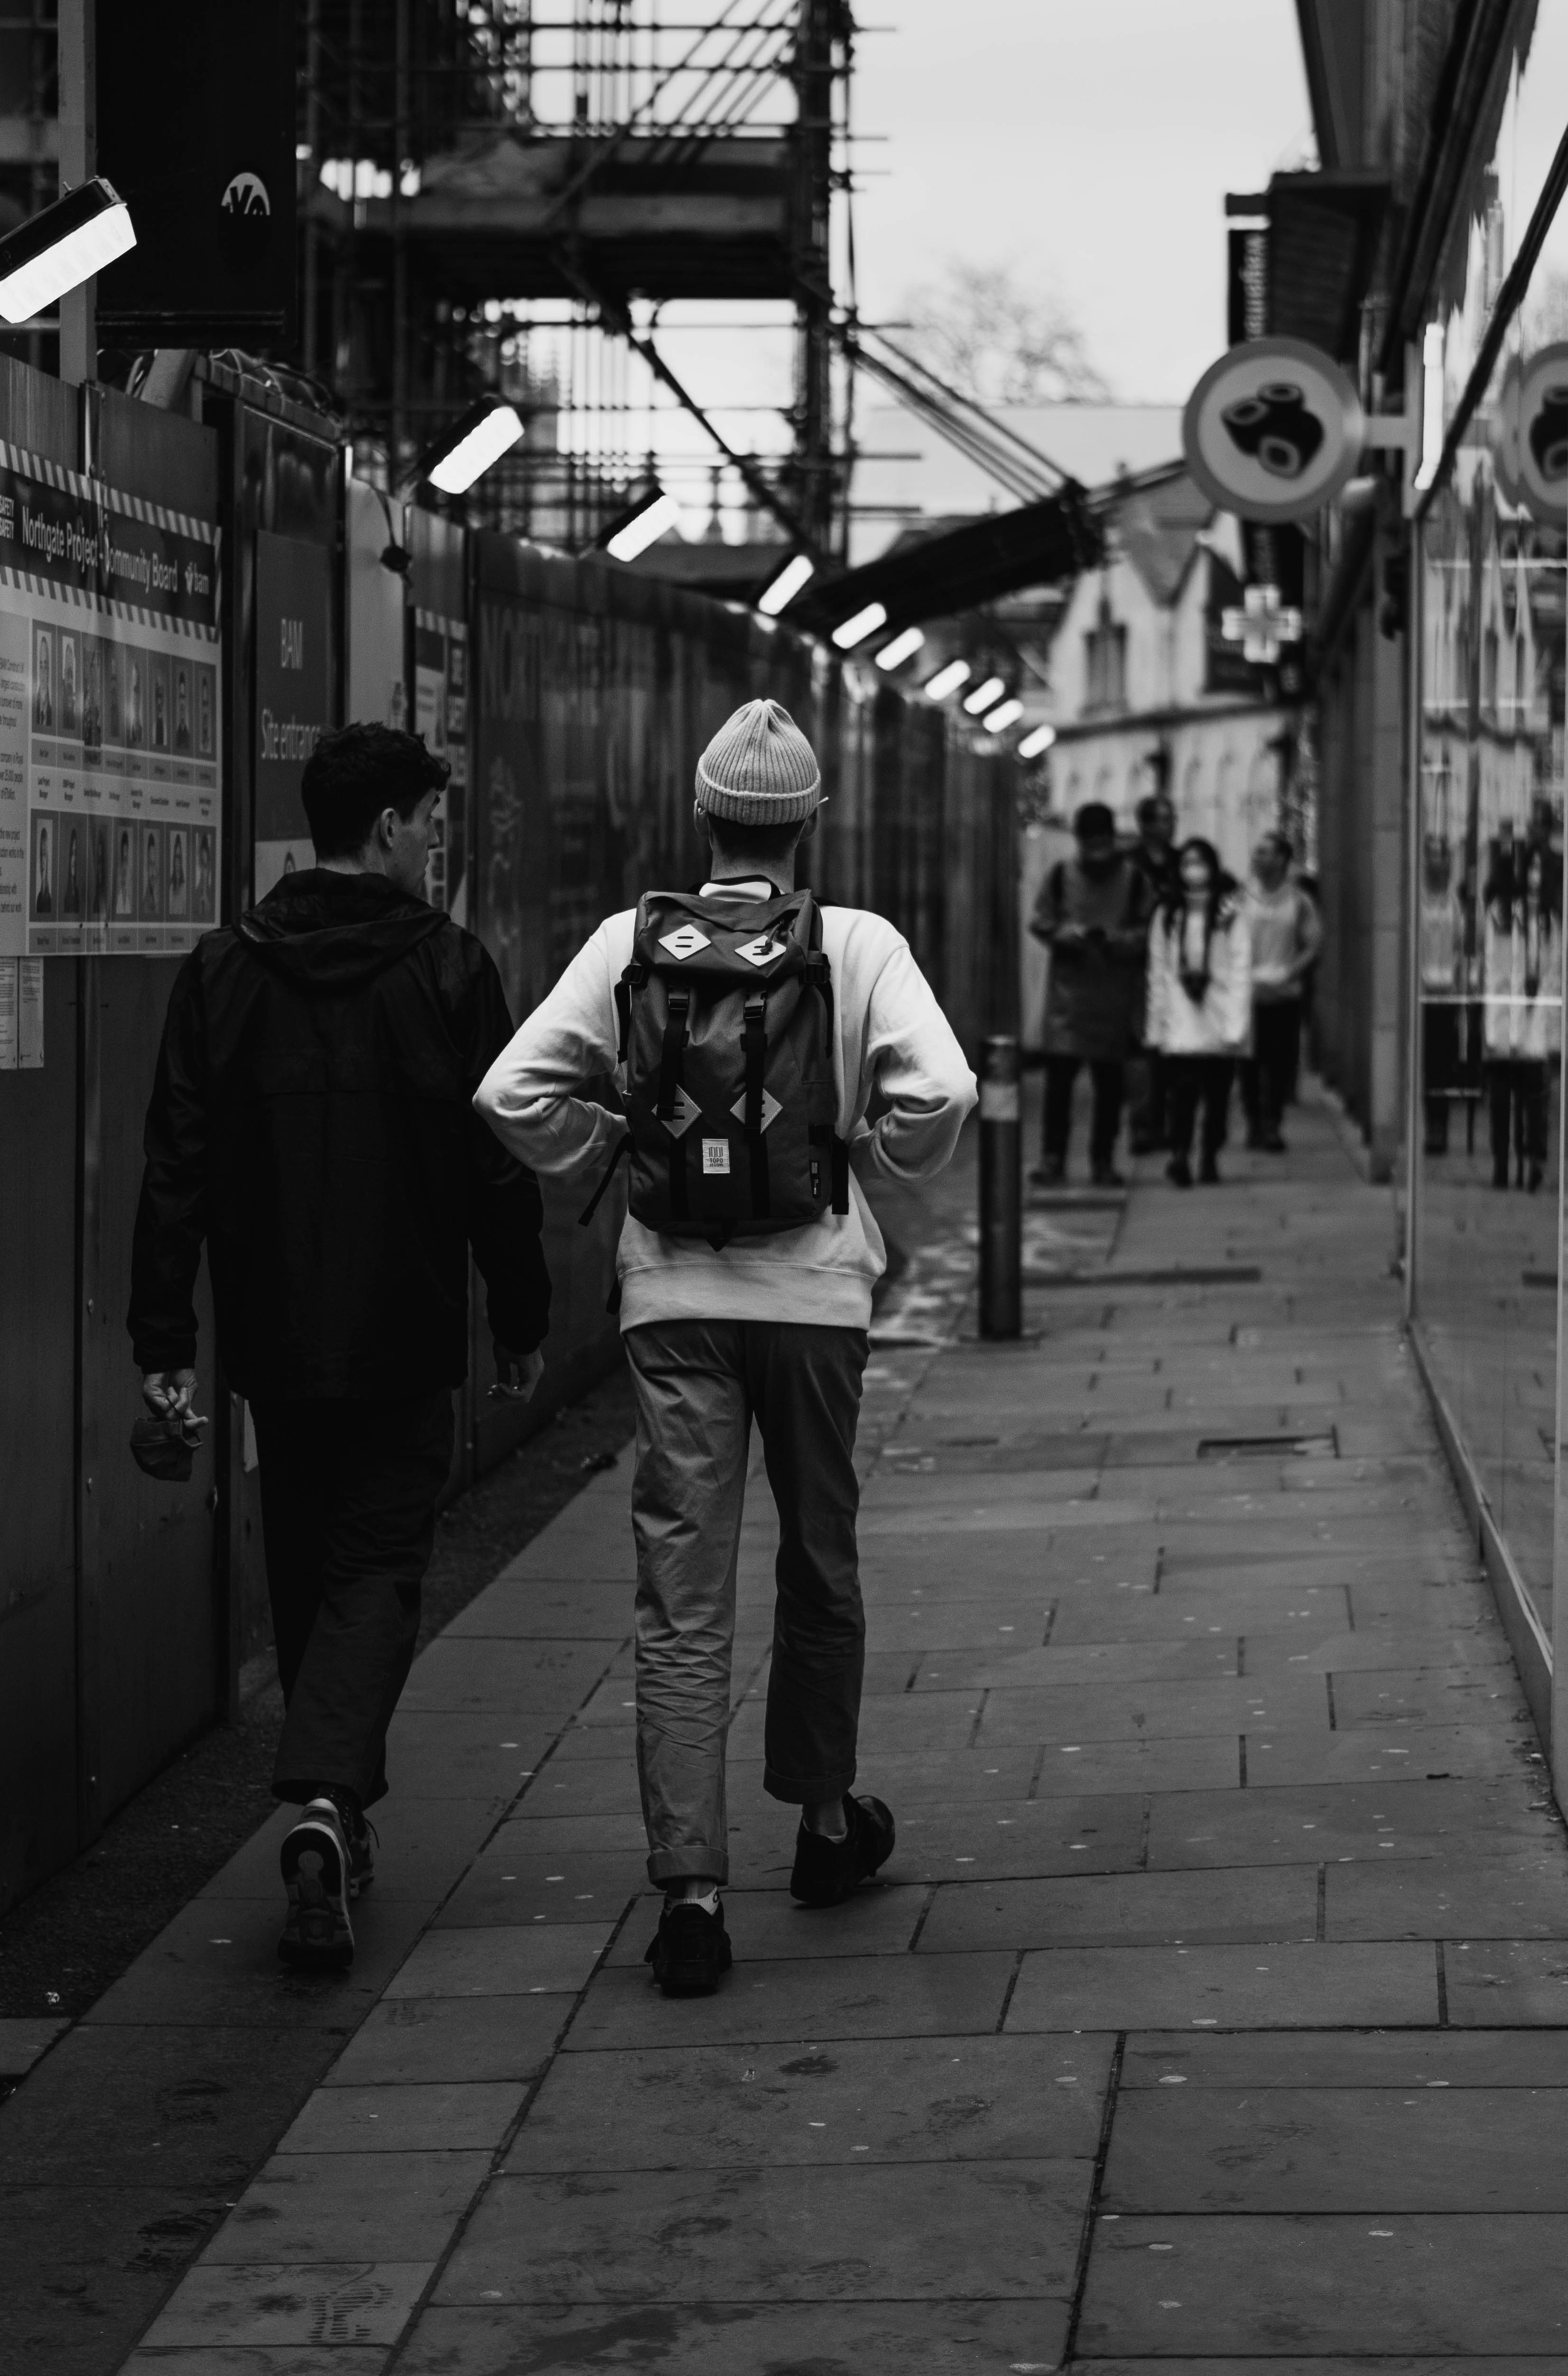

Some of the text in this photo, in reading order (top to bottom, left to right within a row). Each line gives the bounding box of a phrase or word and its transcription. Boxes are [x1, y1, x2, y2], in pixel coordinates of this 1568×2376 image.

[22, 506, 65, 563] Northgate
[67, 522, 98, 573] Project
[153, 552, 178, 593] Board
